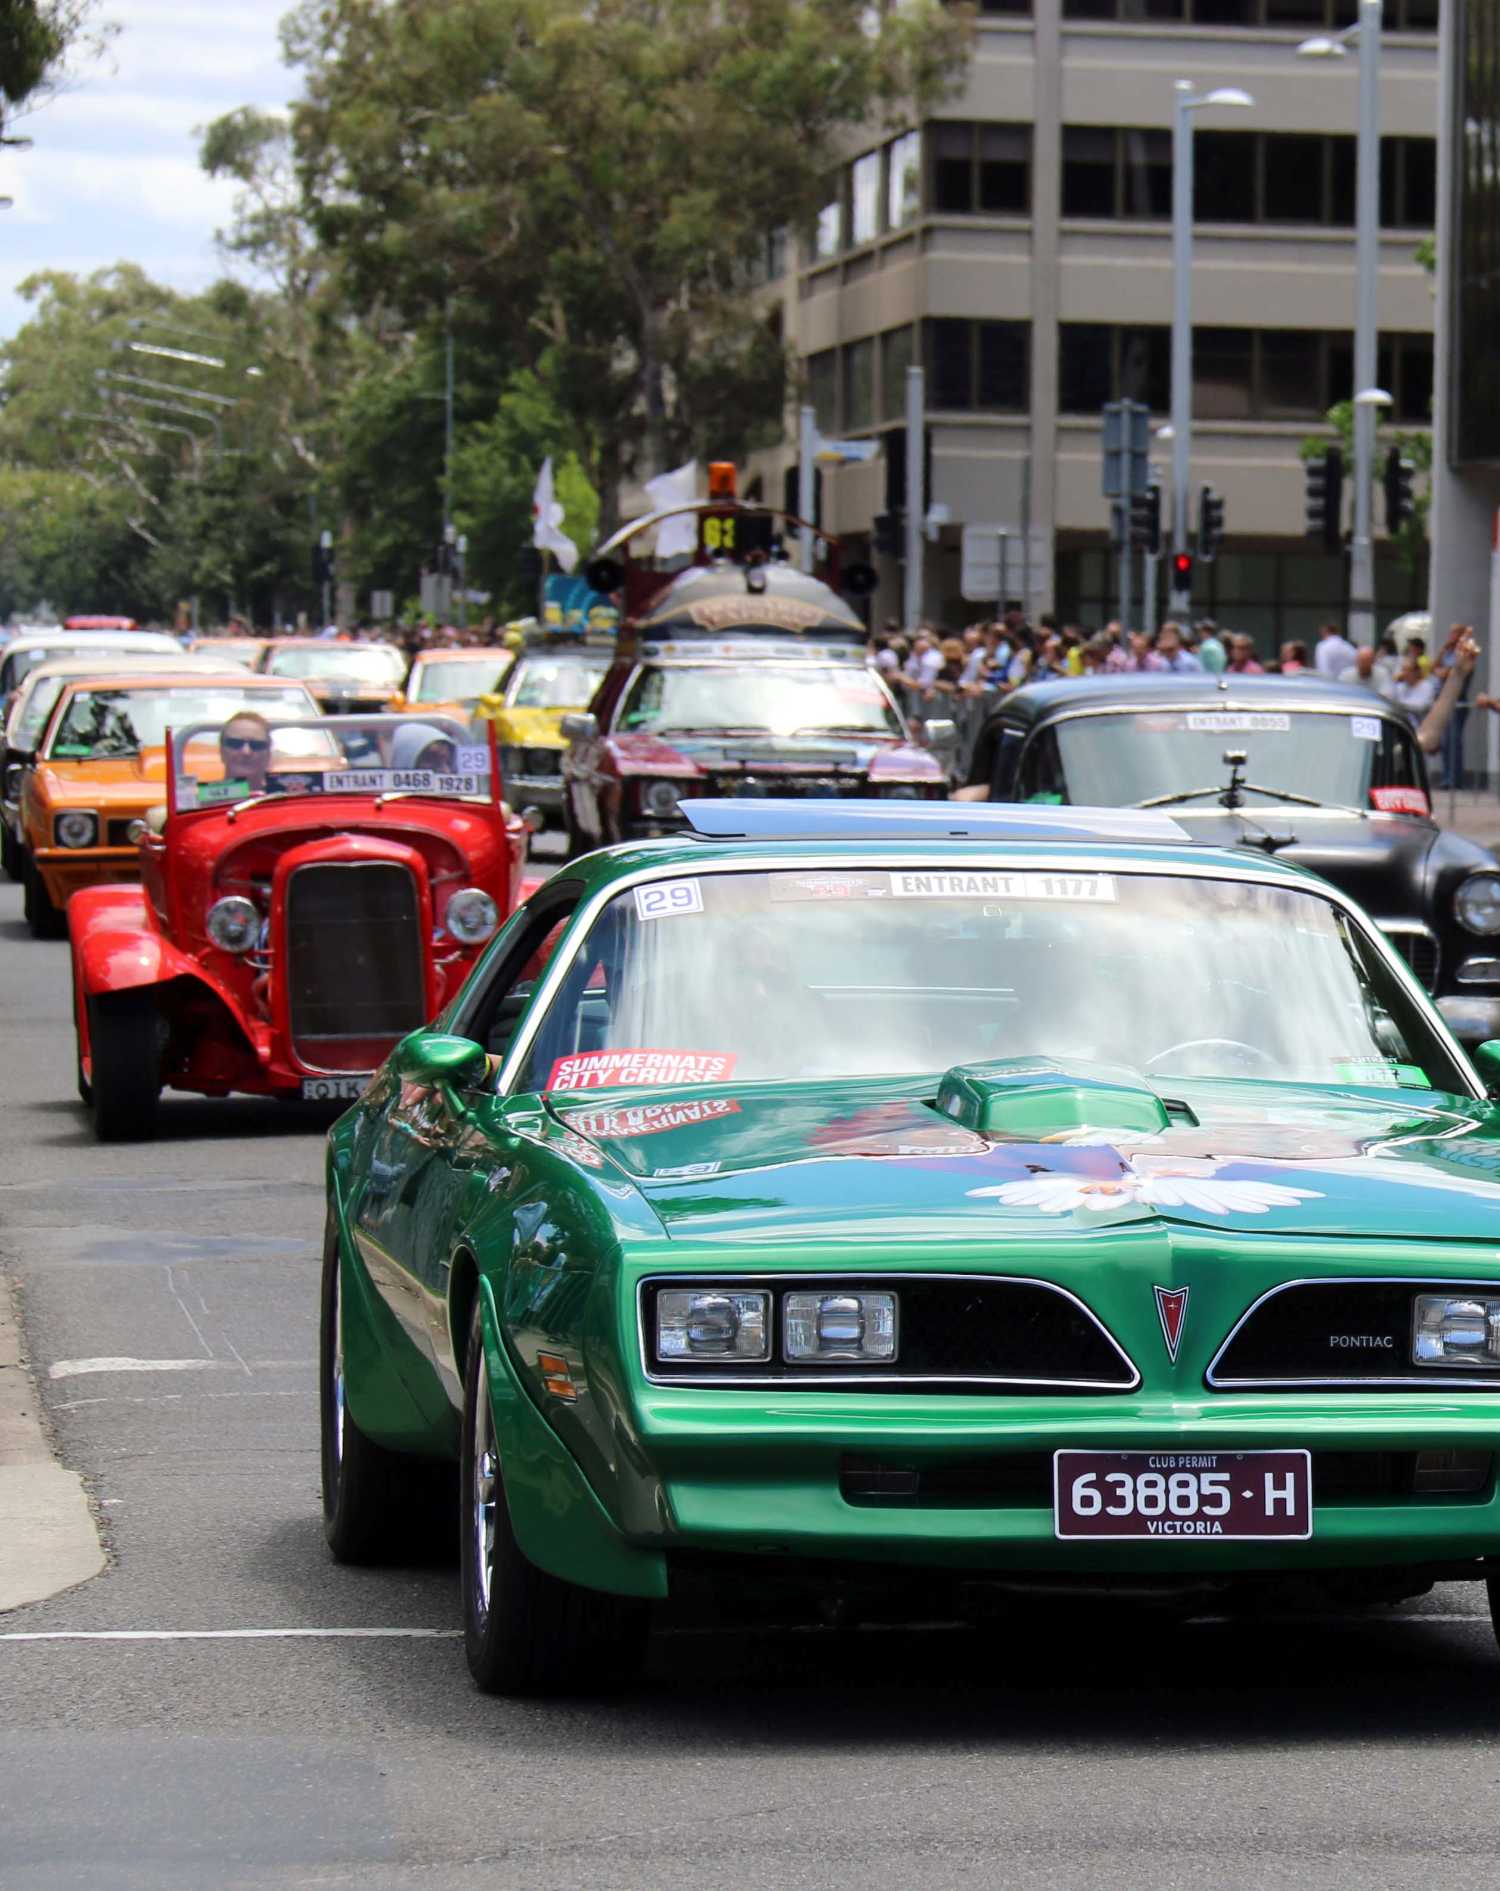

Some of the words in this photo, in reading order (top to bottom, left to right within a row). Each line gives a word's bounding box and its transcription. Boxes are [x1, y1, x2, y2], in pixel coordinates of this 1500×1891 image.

[1354, 721, 1376, 734] 29
[461, 752, 486, 770] 29
[329, 775, 384, 789] ENTRANT
[392, 772, 432, 788] 0468
[901, 876, 1014, 893] ENTRANT
[1041, 878, 1098, 896] 1177
[644, 886, 693, 912] 29
[558, 1053, 726, 1076] SUMMERNATS
[552, 1068, 615, 1090] CITY
[619, 1068, 721, 1084] CRUISE
[1330, 1336, 1393, 1348] PONTIAC
[1149, 1456, 1176, 1468] CLUB
[1178, 1456, 1218, 1468] PERMIT
[1147, 1520, 1223, 1534] VICTORIA
